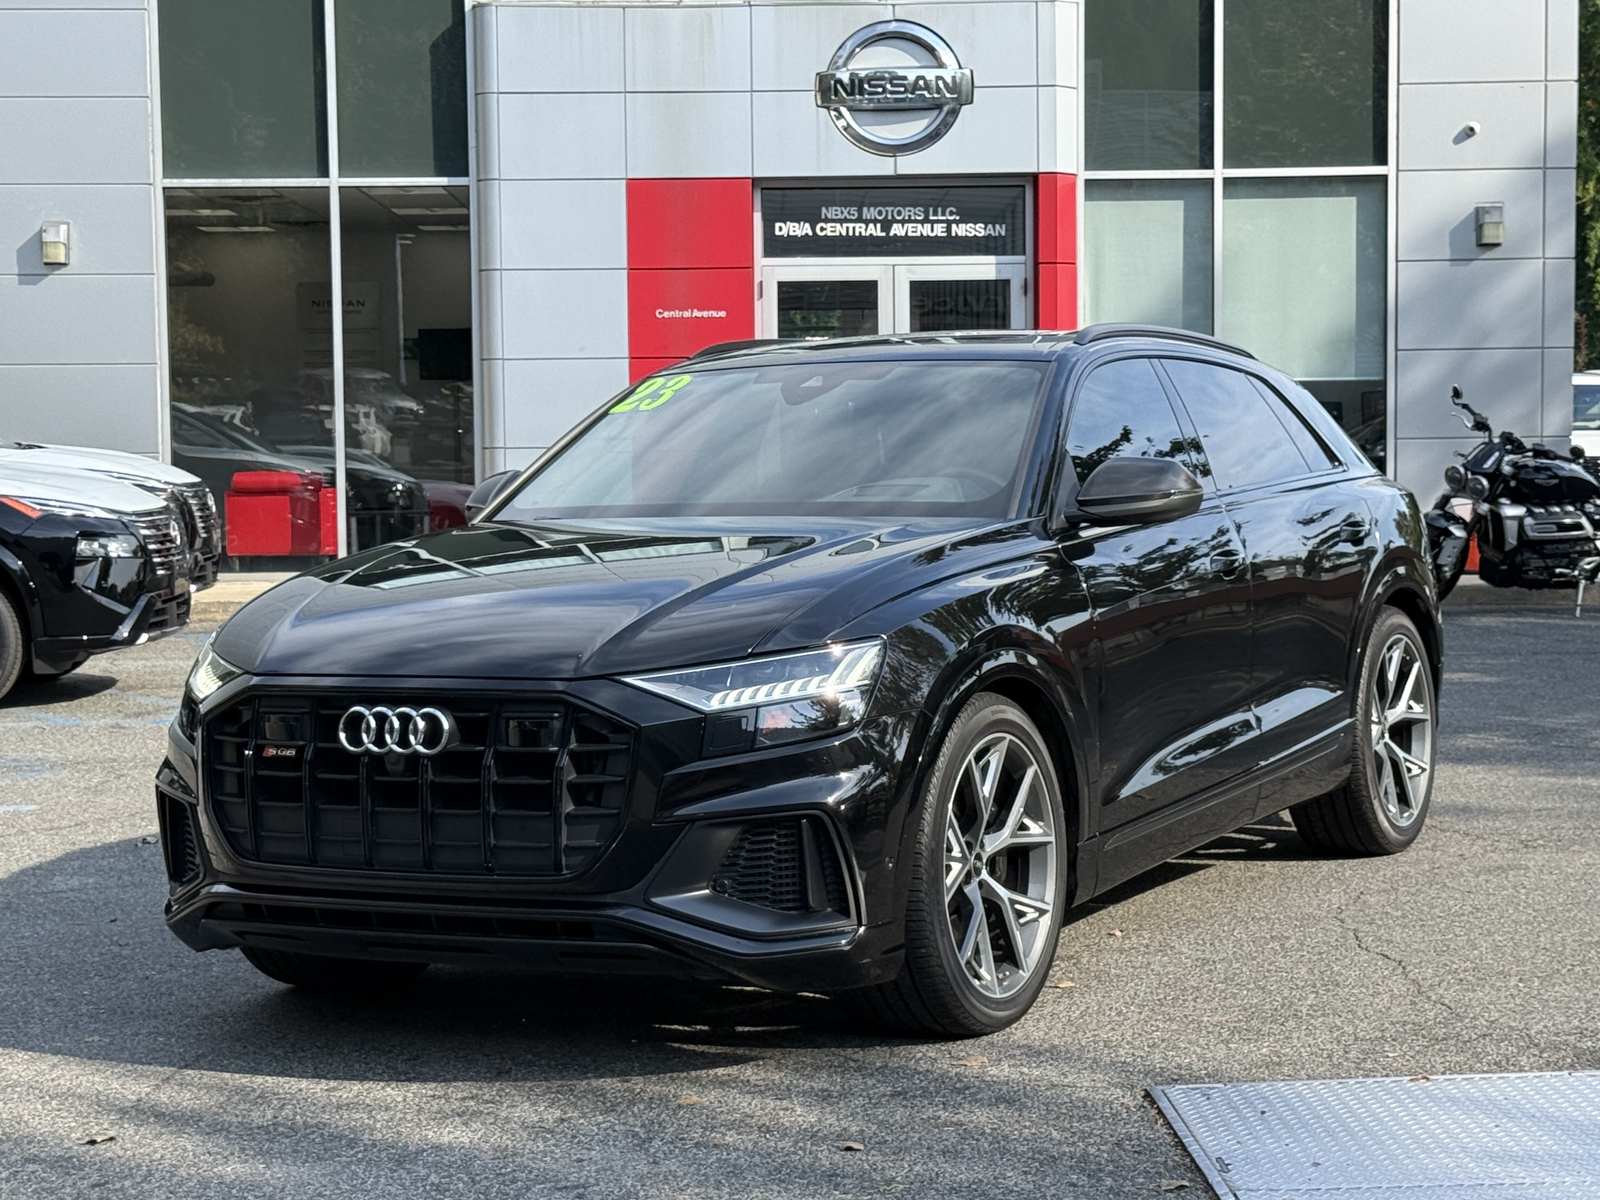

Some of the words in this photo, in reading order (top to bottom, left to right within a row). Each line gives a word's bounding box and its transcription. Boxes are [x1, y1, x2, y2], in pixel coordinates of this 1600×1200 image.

[831, 75, 958, 99] NISSAN
[821, 206, 858, 220] NBX5
[862, 206, 925, 220] MOTORS
[928, 206, 960, 220] LLC.
[774, 221, 813, 238] D/B/A
[815, 222, 887, 237] CENTRAL
[889, 222, 948, 237] AVENUE
[951, 222, 1006, 237] NISSAN
[655, 308, 692, 318] Central
[692, 308, 727, 318] Avenue
[607, 374, 692, 415] 23
